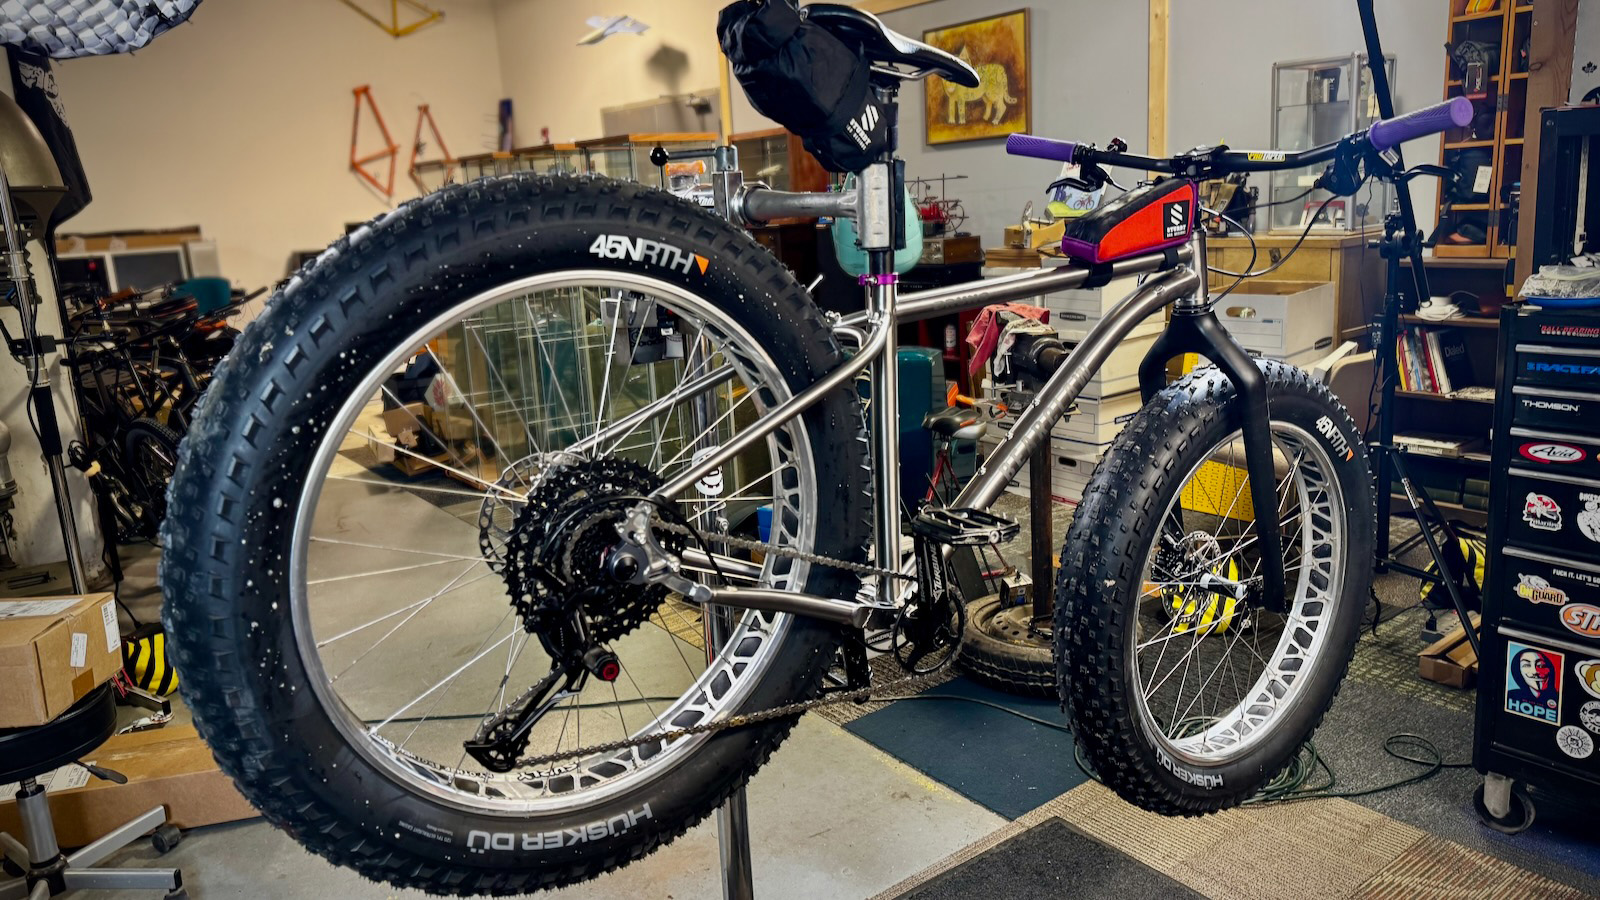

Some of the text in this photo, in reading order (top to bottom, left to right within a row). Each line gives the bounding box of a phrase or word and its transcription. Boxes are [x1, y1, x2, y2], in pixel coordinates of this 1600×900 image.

[589, 234, 695, 275] 45NRTH
[1522, 400, 1579, 412] THOMSON
[1316, 415, 1350, 457] 45NRTH
[1532, 446, 1577, 458] Avid
[930, 543, 943, 591] TURBINE
[1552, 568, 1568, 578] FUCK
[1575, 573, 1592, 583] LET'S
[1508, 698, 1557, 722] HOPE
[1156, 747, 1224, 790] HÜSKER DÜ
[466, 802, 653, 855] HÜSKER DÜ
